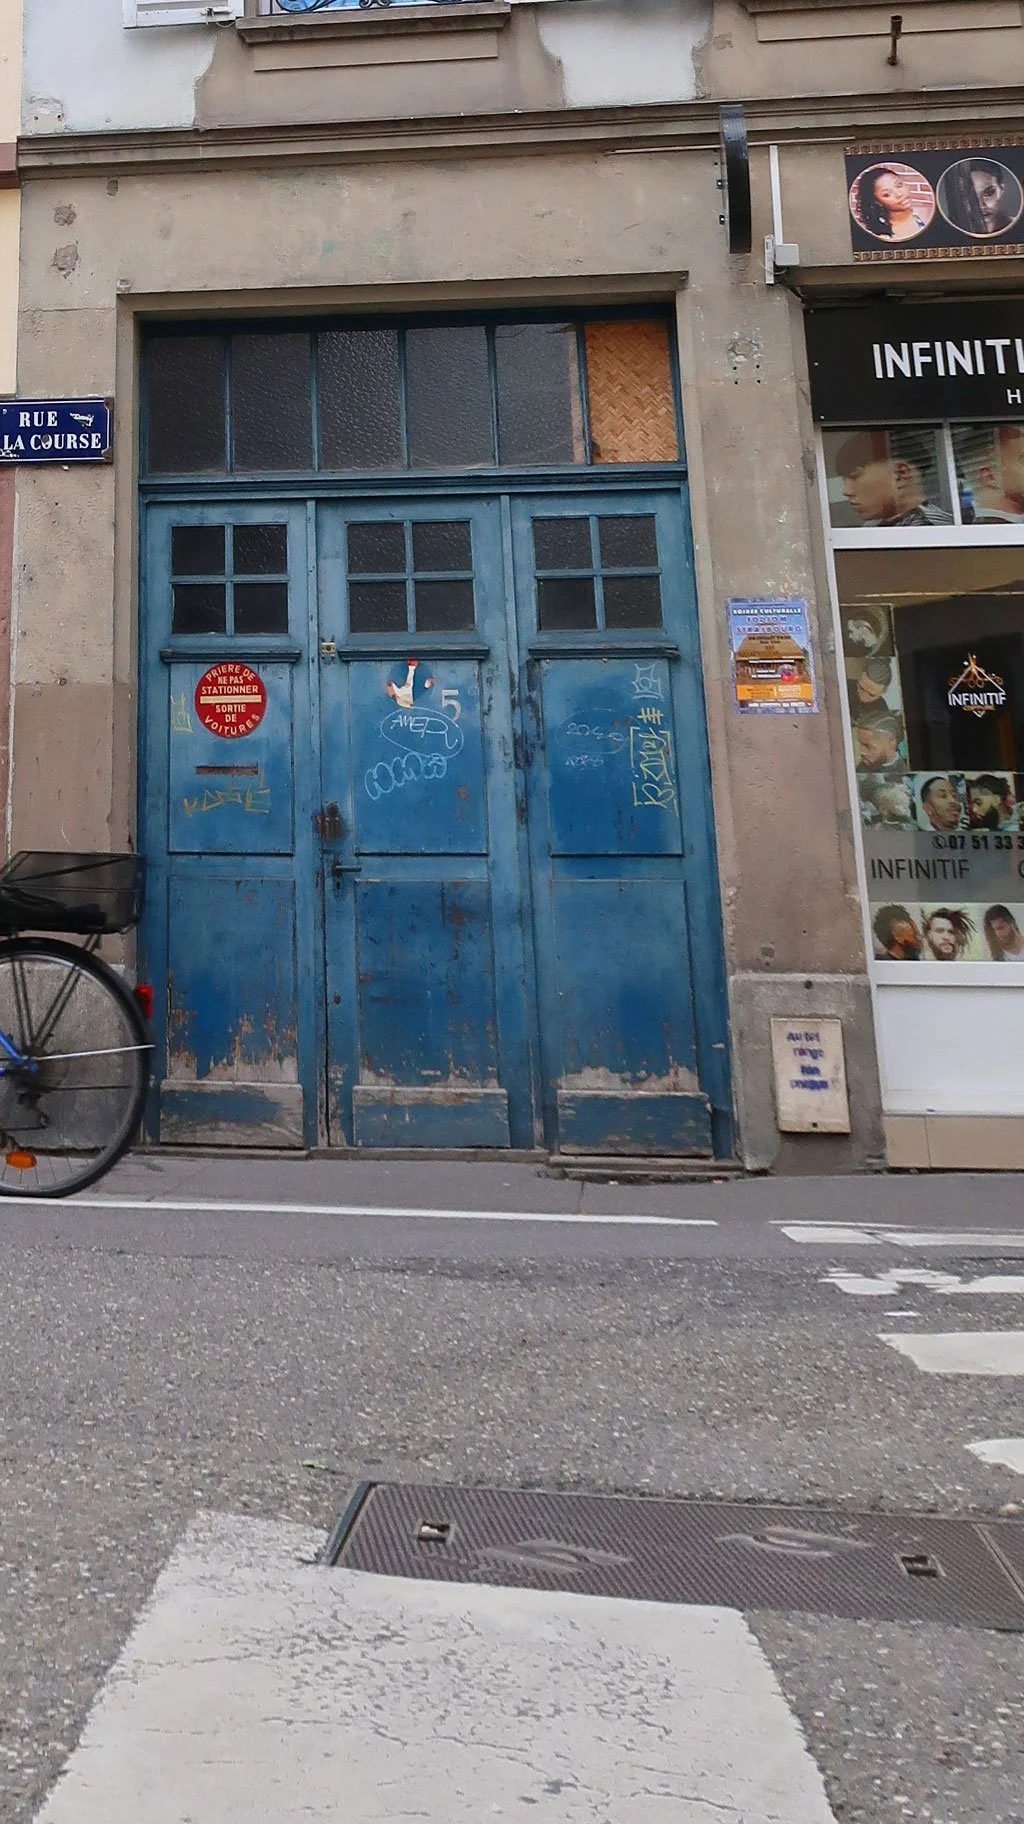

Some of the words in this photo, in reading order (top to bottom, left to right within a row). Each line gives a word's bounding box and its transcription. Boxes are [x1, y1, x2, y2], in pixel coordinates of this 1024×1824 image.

[19, 411, 58, 427] RUE
[3, 434, 25, 451] LA
[30, 433, 102, 450] COURSE
[218, 676, 228, 684] NE
[229, 675, 244, 684] PAS
[242, 668, 256, 681] DE
[201, 685, 259, 694] STATIONNER
[947, 692, 1006, 706] INFINITIF
[216, 704, 247, 713] SORTIE
[204, 713, 260, 735] VOITURES
[225, 714, 237, 722] DE
[949, 835, 965, 849] 07
[972, 835, 989, 849] 51
[995, 835, 1013, 849] 33
[870, 858, 970, 879] INFINITIF
